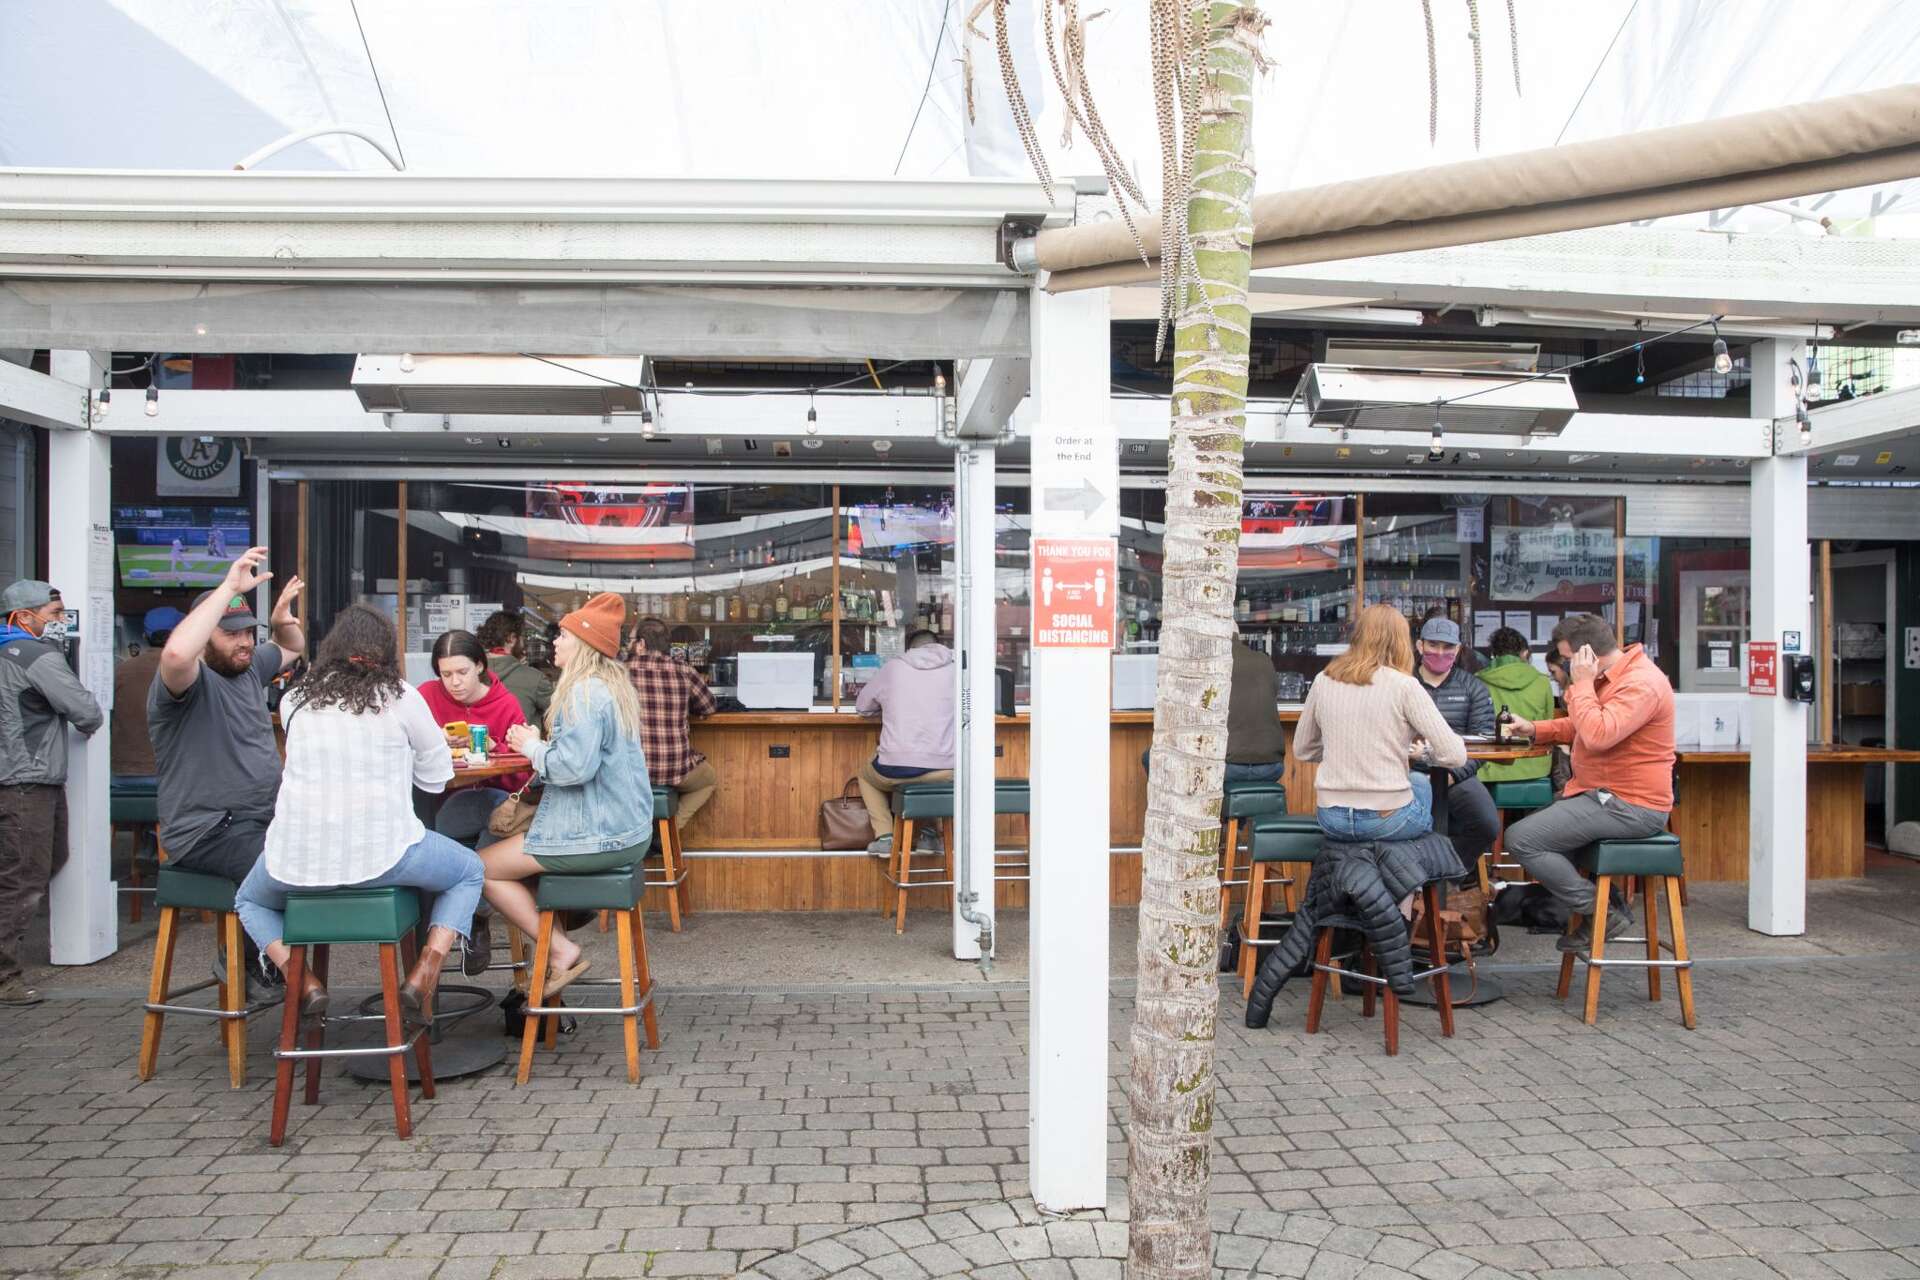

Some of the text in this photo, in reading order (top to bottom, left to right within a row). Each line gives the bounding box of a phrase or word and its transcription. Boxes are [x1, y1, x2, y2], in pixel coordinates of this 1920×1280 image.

[1055, 436, 1093, 446] Order at
[1056, 451, 1092, 461] the End
[174, 459, 225, 478] ATHLETICS
[1038, 545, 1112, 558] THANK YOU FOR
[1546, 564, 1573, 578] August
[1575, 564, 1587, 577] 1st
[1588, 565, 1597, 577] &
[1598, 565, 1613, 577] 2nd
[1052, 613, 1094, 628] SOCIAL
[1038, 629, 1109, 644] DISTANCING
